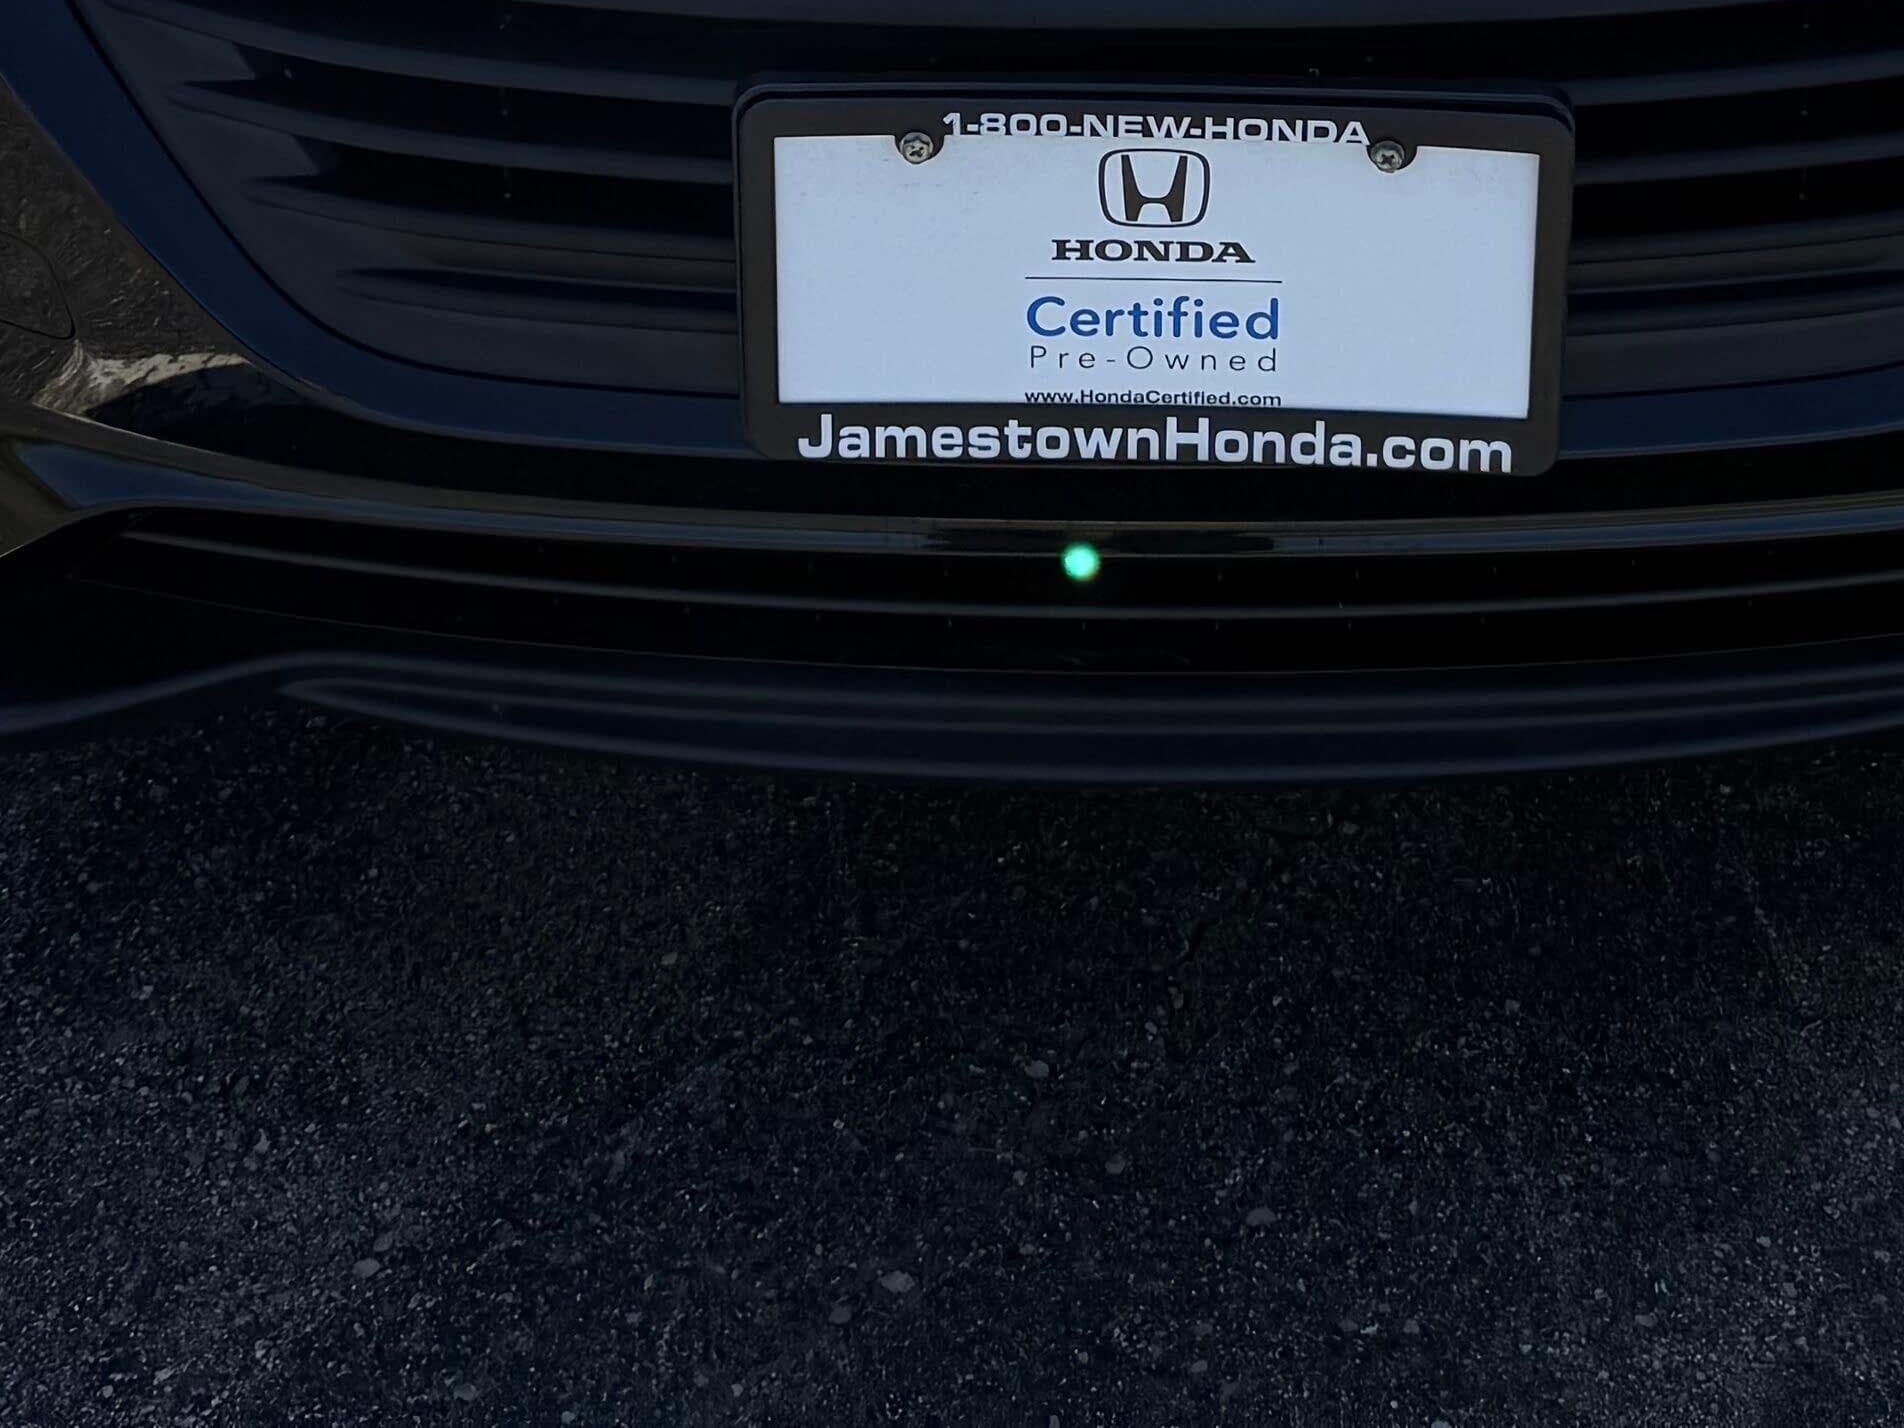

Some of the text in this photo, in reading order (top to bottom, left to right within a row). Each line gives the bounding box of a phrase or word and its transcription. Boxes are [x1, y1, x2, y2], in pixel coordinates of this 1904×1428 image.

[942, 112, 1370, 145] 1-800-NEW-HONDA
[1051, 239, 1256, 263] HONDA
[1026, 295, 1279, 340] Certified
[1030, 345, 1277, 372] Pre-Owned
[1024, 390, 1282, 406] www.HondaCertified.com
[797, 414, 1514, 473] JamestownHonda.com
